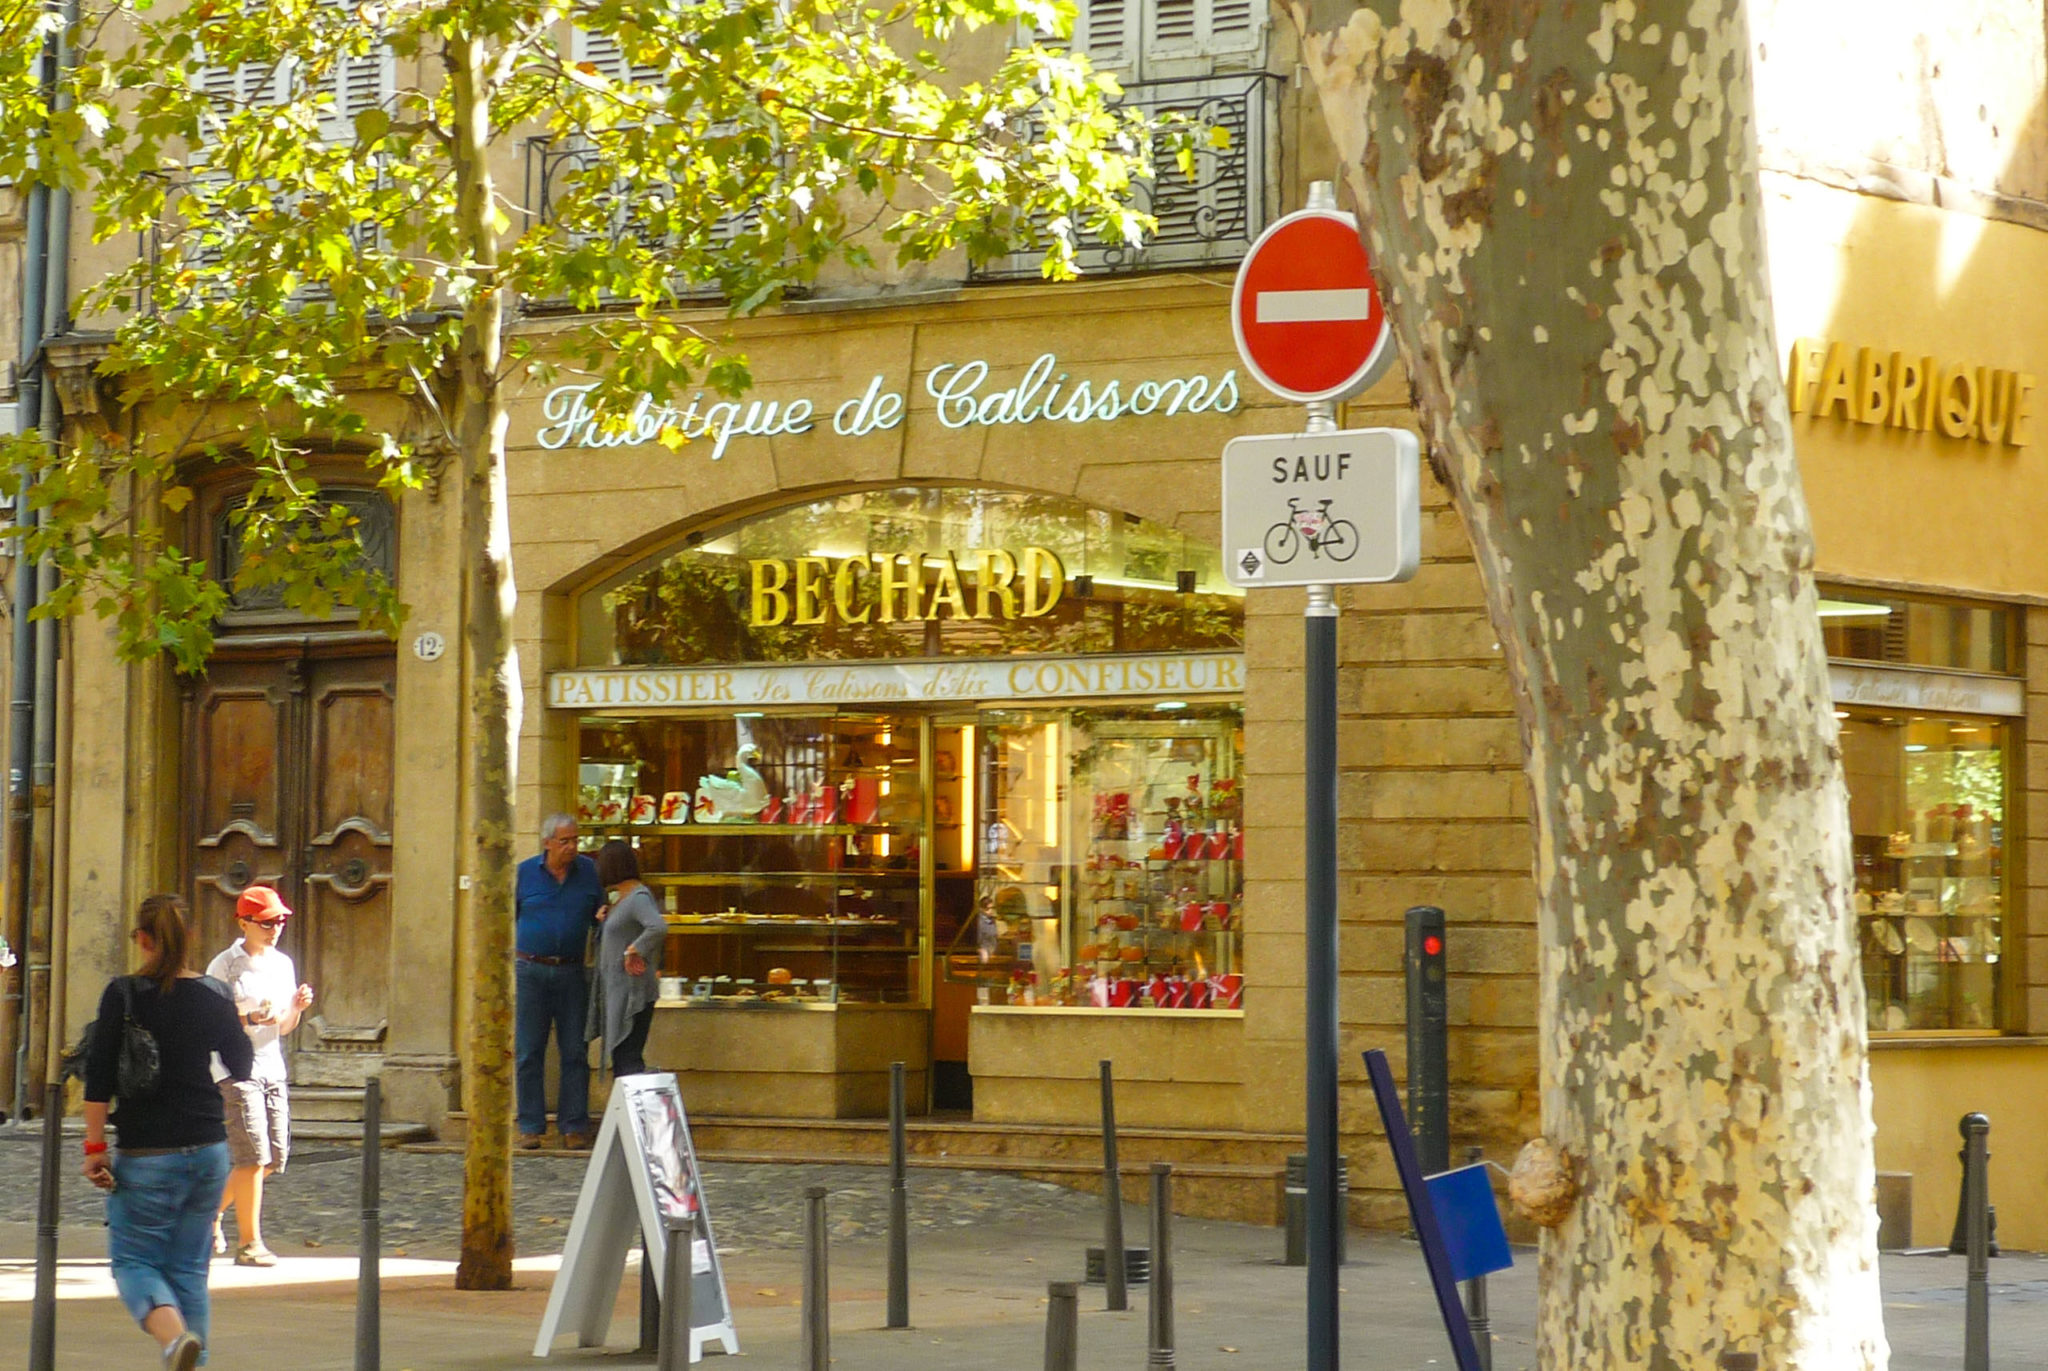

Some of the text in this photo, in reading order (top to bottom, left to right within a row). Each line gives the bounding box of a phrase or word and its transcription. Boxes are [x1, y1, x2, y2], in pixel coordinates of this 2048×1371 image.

[833, 374, 905, 436] de
[926, 353, 1240, 429] Calissons
[1789, 337, 2037, 448] FABRIQUE
[1272, 453, 1351, 483] SAUF
[748, 546, 1066, 628] BECHARD
[419, 636, 437, 656] 12
[557, 672, 736, 703] PATISSIER
[802, 667, 908, 700] Calissons
[1007, 656, 1240, 694] CONFISEUR
